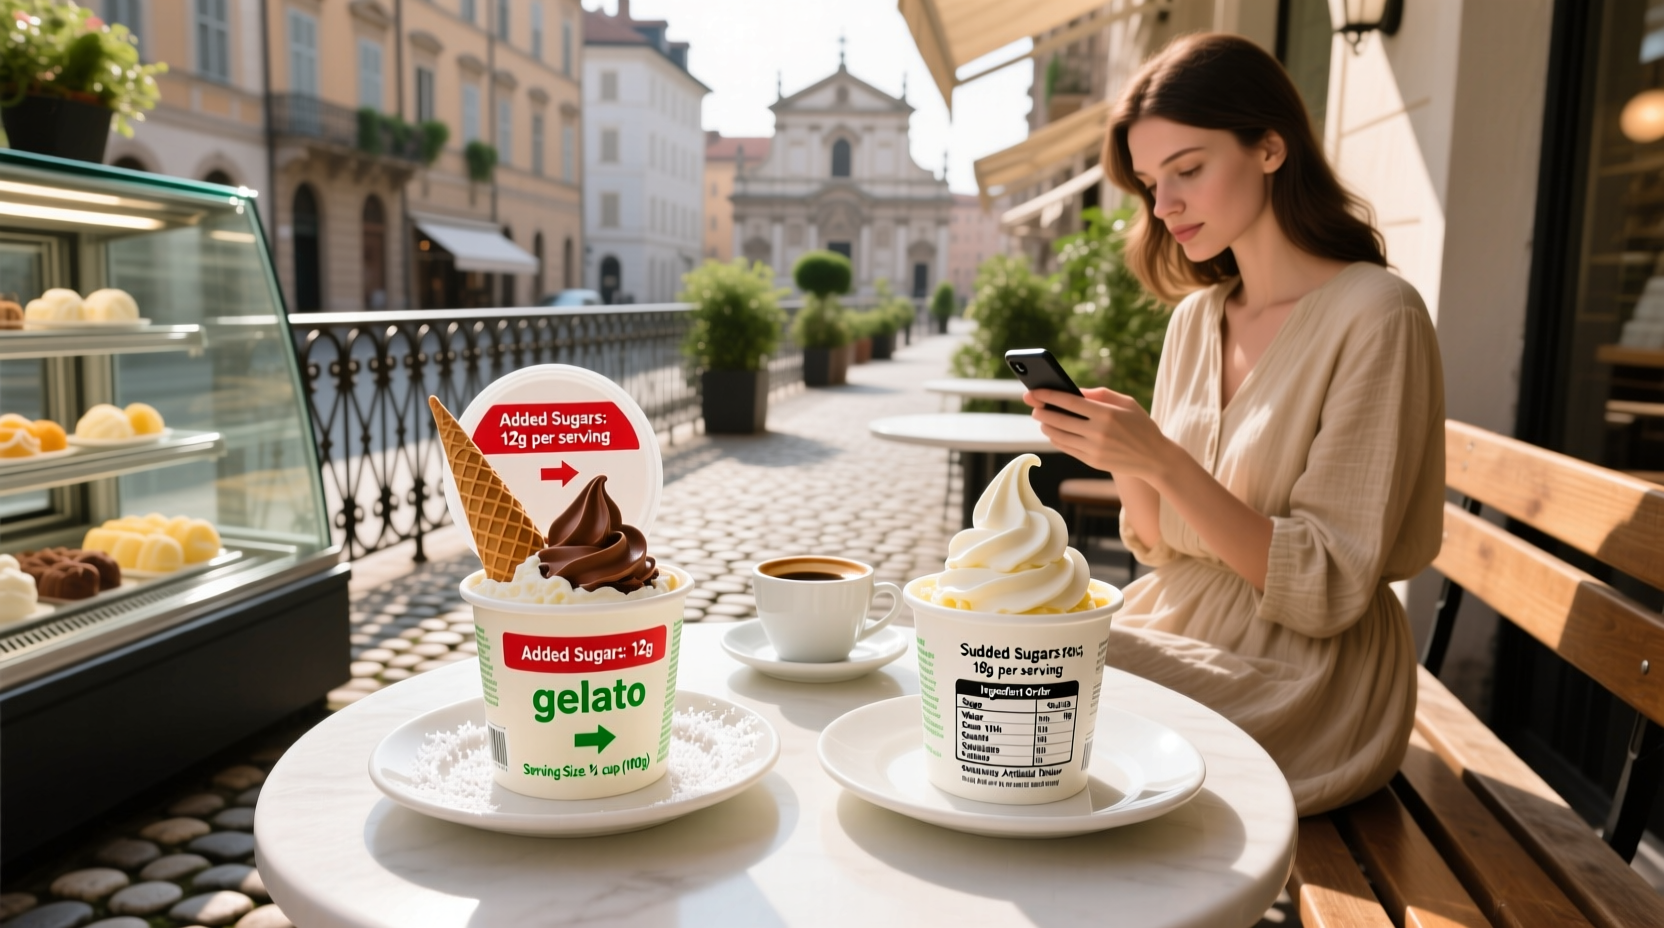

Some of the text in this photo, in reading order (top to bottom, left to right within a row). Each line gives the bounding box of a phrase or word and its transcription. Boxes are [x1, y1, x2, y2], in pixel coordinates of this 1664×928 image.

[499, 411, 607, 429] Added Sugars:
[500, 430, 611, 449] 12g per serving
[521, 645, 570, 662] Added
[632, 639, 653, 657] 12g
[960, 643, 1010, 659] Sudded
[998, 666, 1018, 680] per
[1020, 664, 1063, 678] serving
[532, 679, 646, 723] gelato
